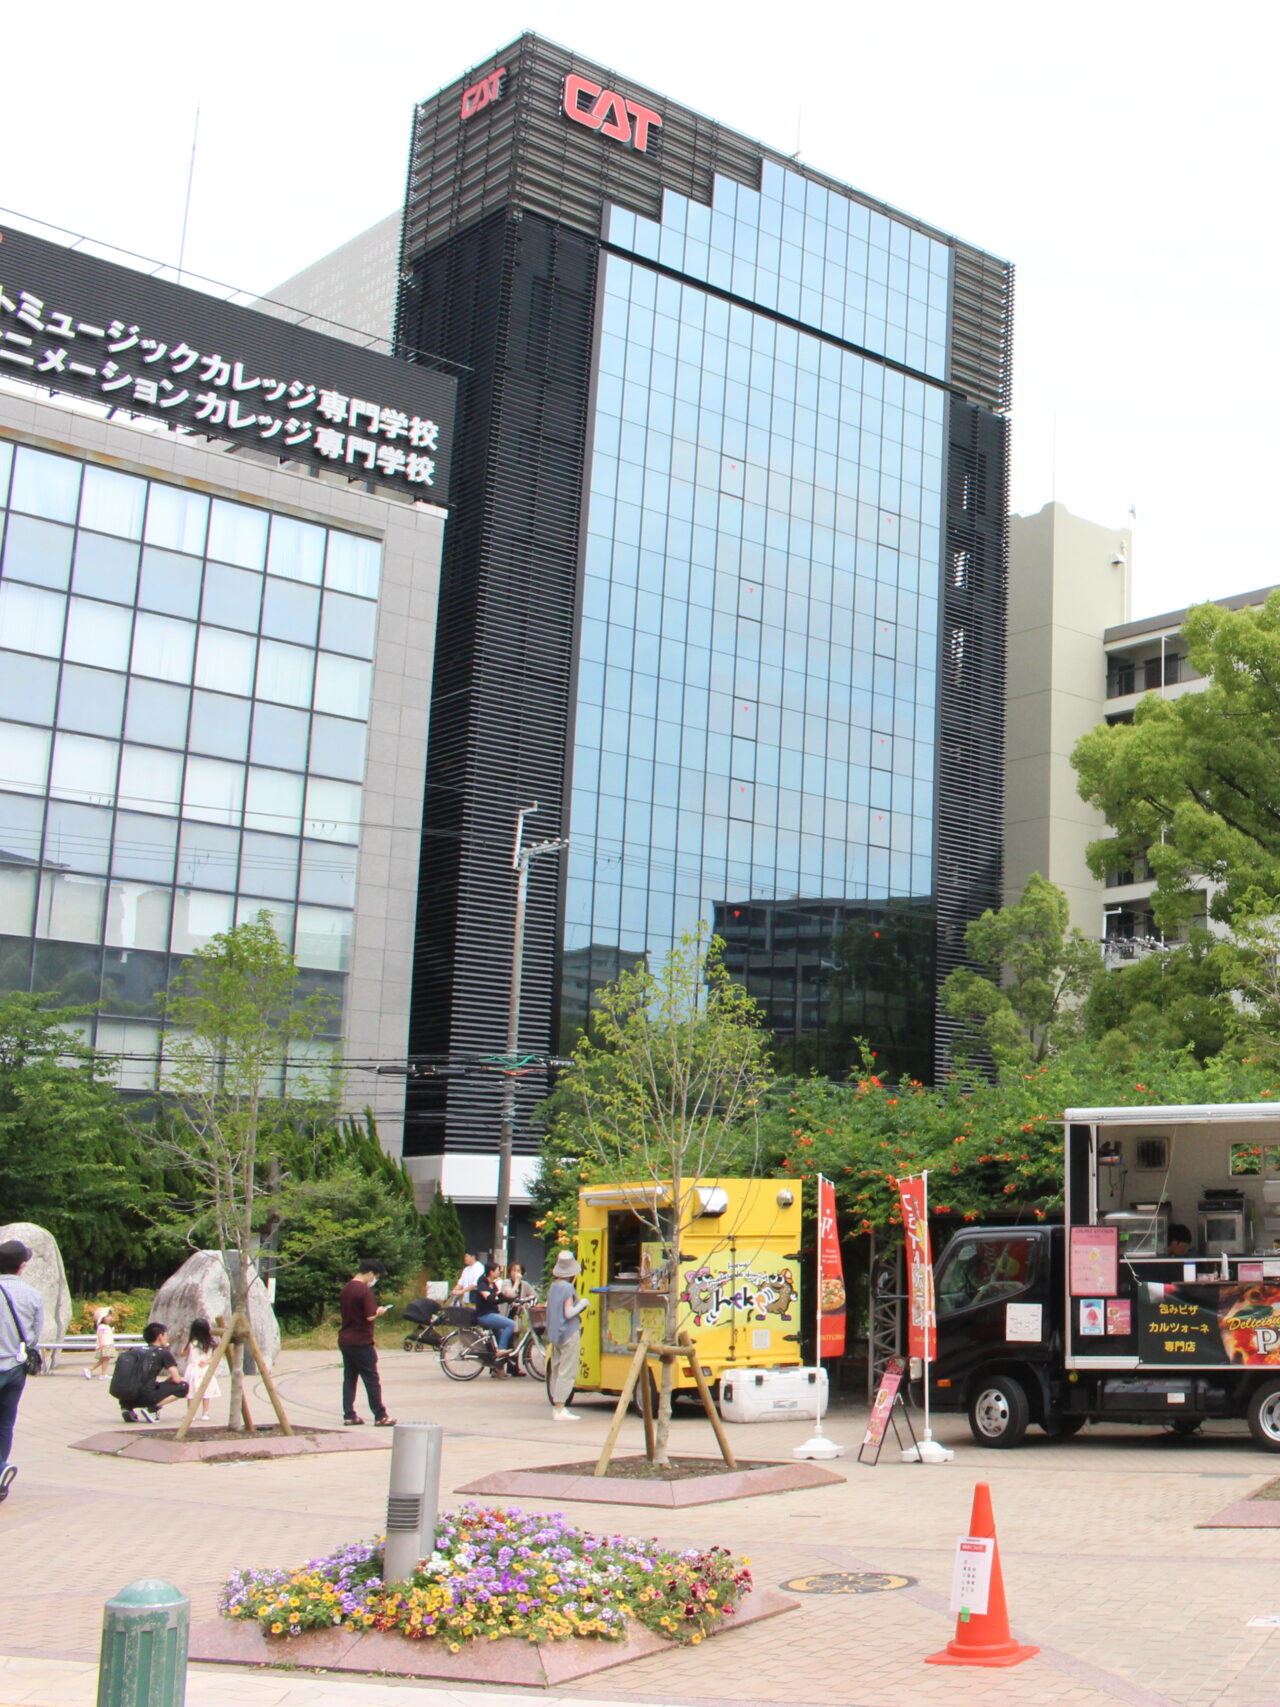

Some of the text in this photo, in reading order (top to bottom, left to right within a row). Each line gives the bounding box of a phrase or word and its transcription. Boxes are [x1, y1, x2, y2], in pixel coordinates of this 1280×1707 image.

[461, 66, 506, 120] CAT
[563, 73, 663, 152] CAT
[0, 330, 436, 486] ニメーションカレッジ専門学校
[1158, 1303, 1199, 1315] 包みピザ
[1149, 1322, 1210, 1334] カルツォーネ
[1164, 1341, 1197, 1353] 専門店
